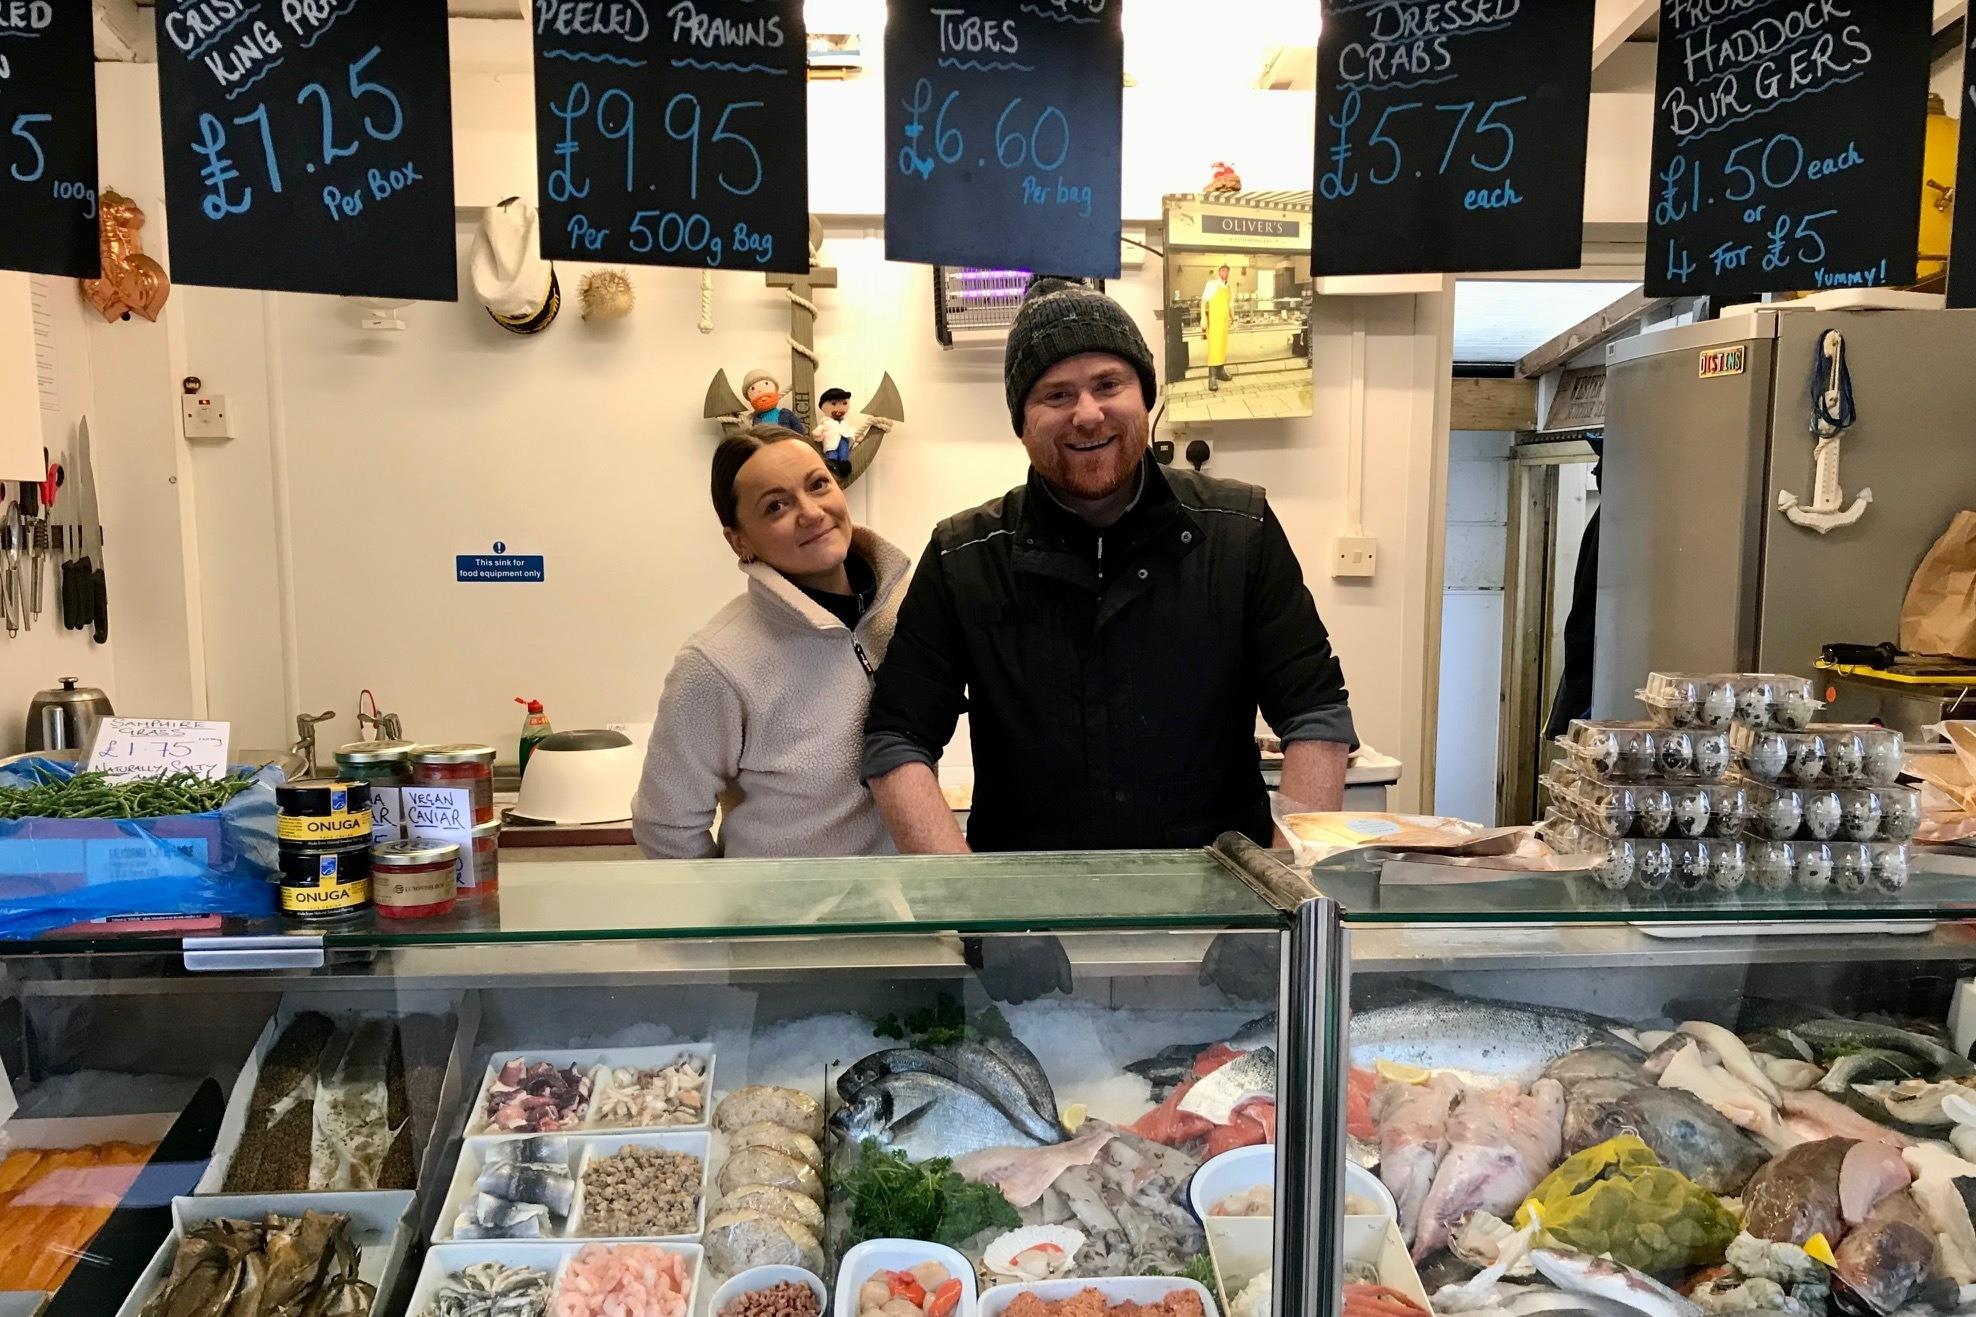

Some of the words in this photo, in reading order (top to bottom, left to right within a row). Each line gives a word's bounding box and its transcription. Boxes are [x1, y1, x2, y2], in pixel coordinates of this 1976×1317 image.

[535, 0, 649, 42] PEELED
[667, 0, 784, 47] PRAWNS
[930, 8, 1019, 53] TUBES
[1366, 0, 1520, 42] DRESSED
[1684, 0, 1851, 81] HADDOCK
[204, 21, 283, 86] KING
[1339, 37, 1451, 82] CRABS
[548, 81, 765, 202] £9.95
[899, 78, 1069, 181] £6.60
[1320, 90, 1527, 200] £5.75
[323, 186, 364, 221] Per
[369, 162, 423, 200] Box
[1022, 175, 1051, 205] Per
[1057, 177, 1092, 217] bag
[1463, 179, 1523, 210] each
[1655, 134, 1804, 225] £1.50
[1807, 142, 1864, 180] each
[53, 181, 96, 219] 100g
[1743, 205, 1767, 223] or
[567, 214, 609, 250] Per
[629, 210, 722, 266] 500g
[733, 222, 772, 263] Bag
[1222, 218, 1283, 234] OLIVER'S
[1667, 239, 1696, 283] 4
[1762, 210, 1838, 272] £5
[1814, 259, 1887, 287] Yummy!
[460, 569, 478, 577] food
[480, 569, 522, 579] equipment
[524, 569, 541, 579] only
[475, 559, 493, 567] This
[494, 559, 512, 567] sink
[513, 559, 525, 567] for
[110, 718, 205, 729] SAMPHIRE
[119, 727, 186, 736] GRASS
[95, 762, 163, 773] NATURALLY
[408, 807, 466, 829] CAVIAR
[409, 792, 454, 806] VEGAN
[307, 819, 360, 832] ONUGA
[296, 889, 350, 903] ONUGA
